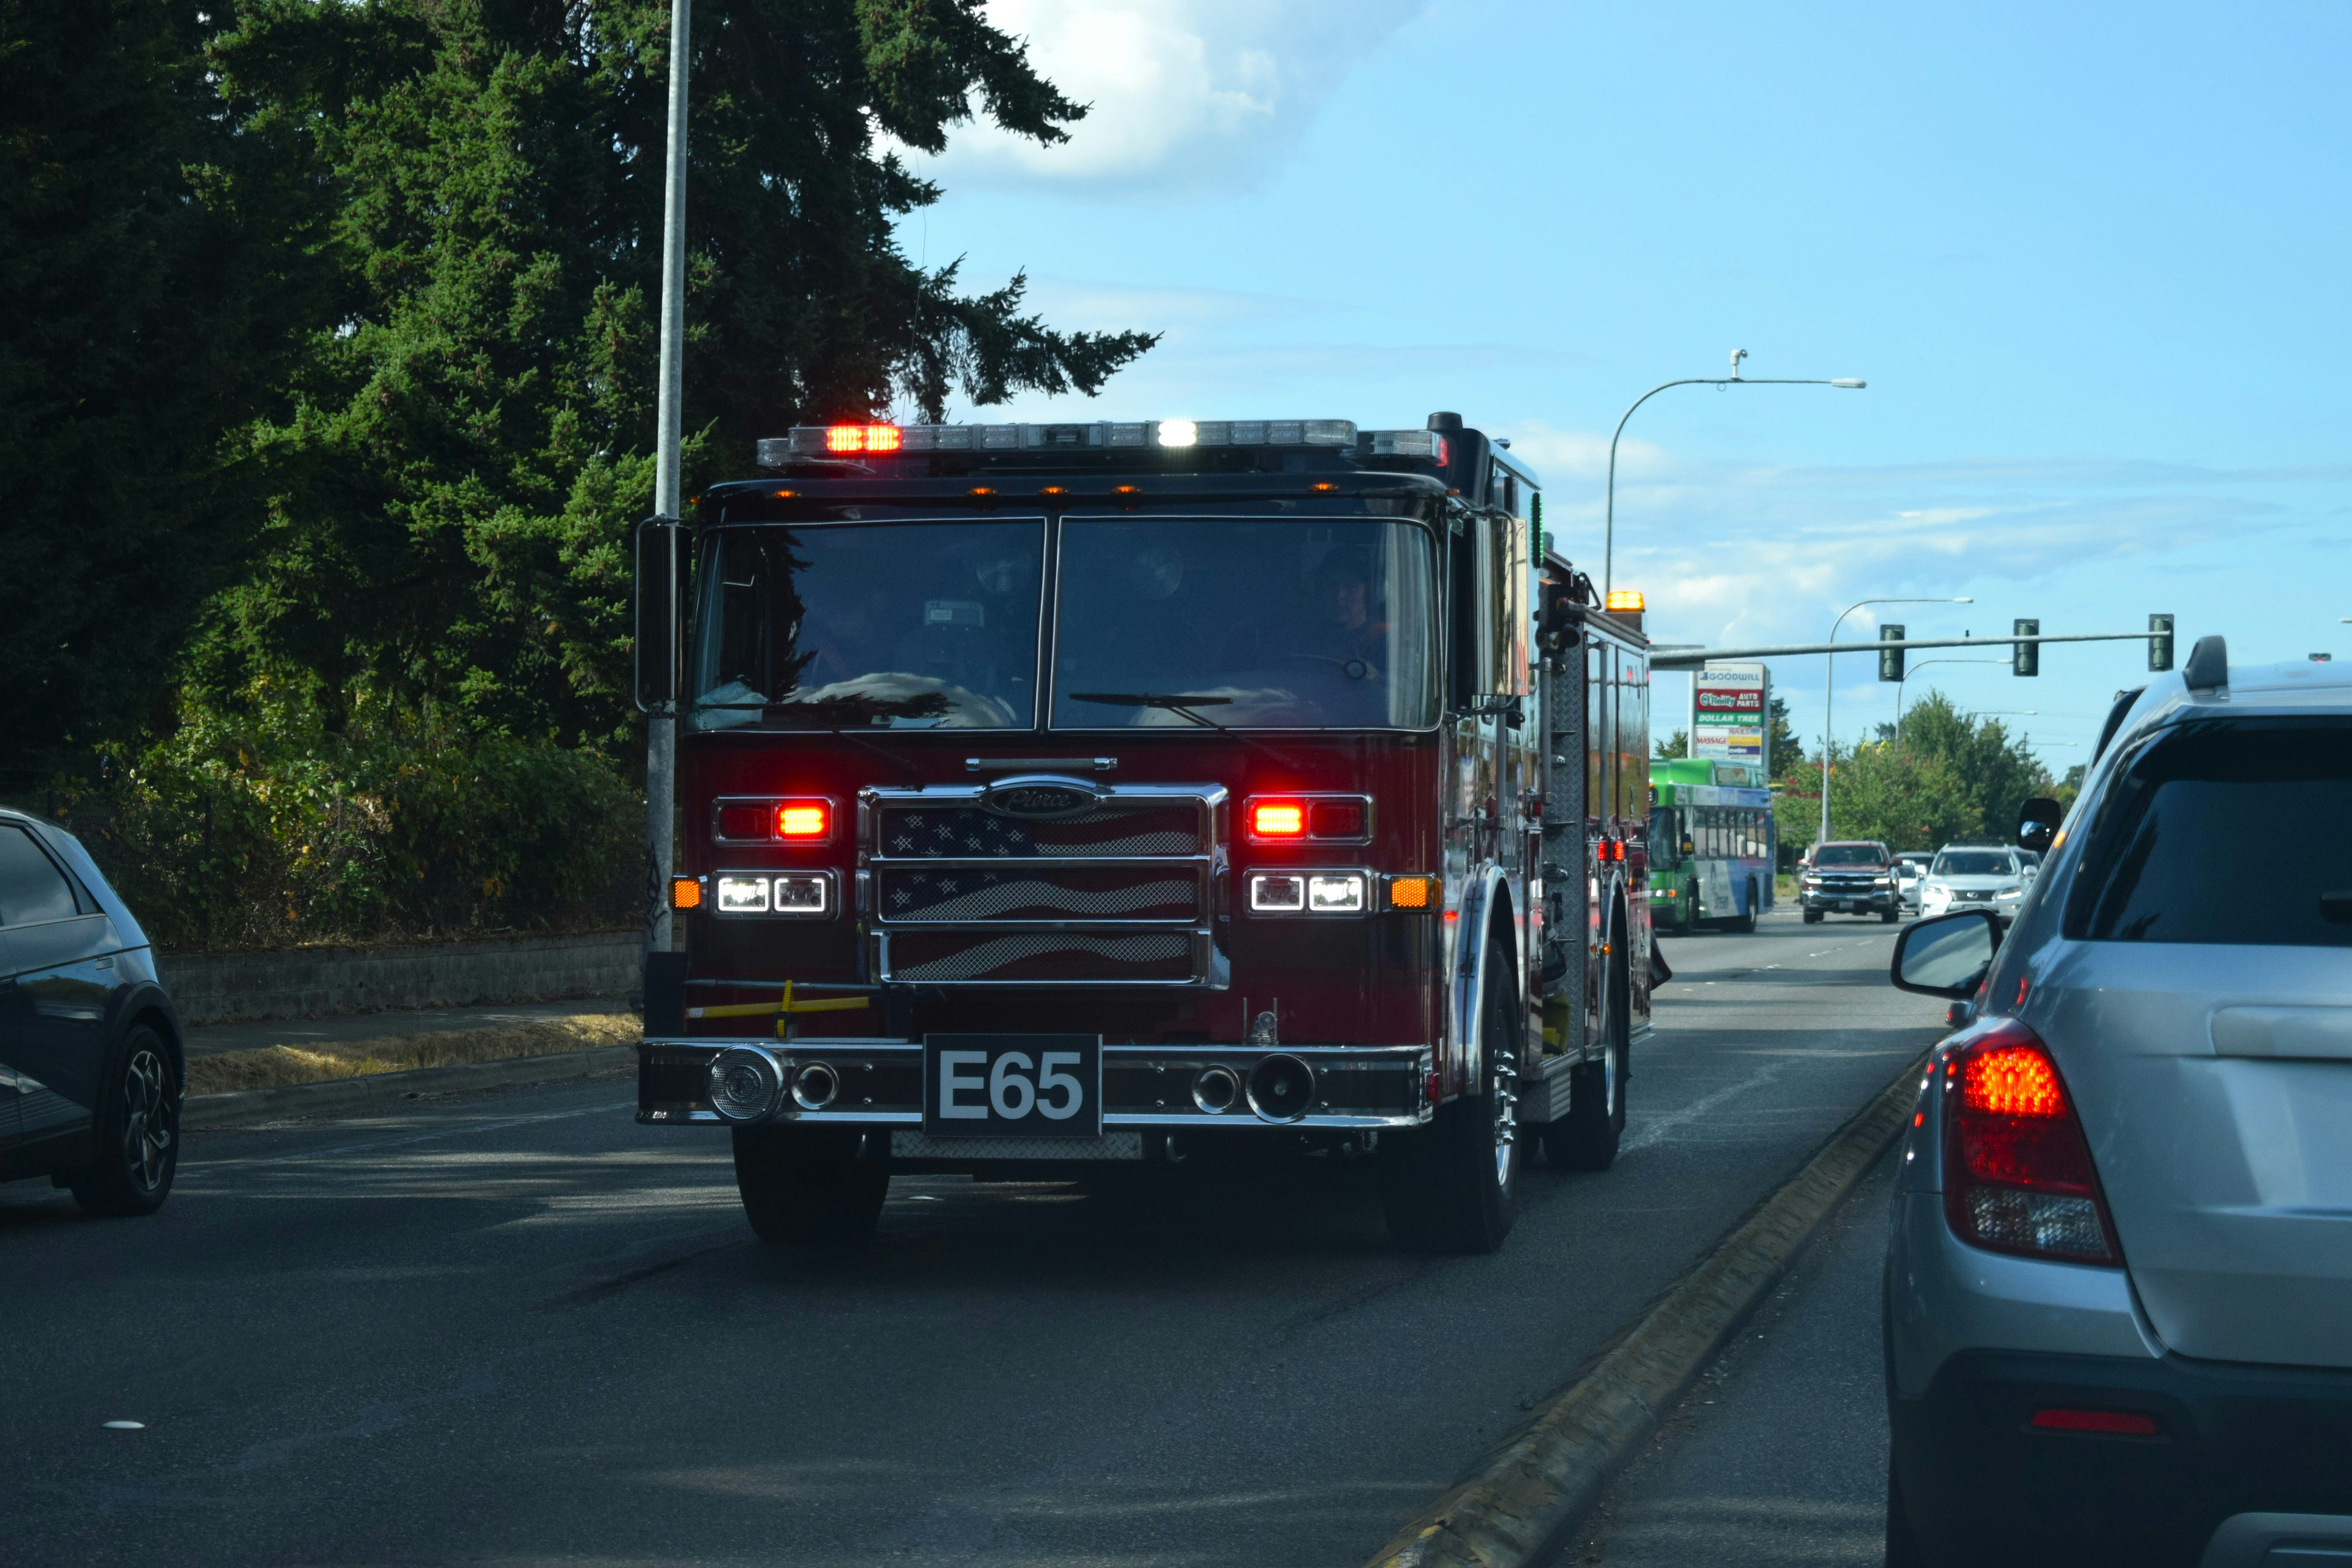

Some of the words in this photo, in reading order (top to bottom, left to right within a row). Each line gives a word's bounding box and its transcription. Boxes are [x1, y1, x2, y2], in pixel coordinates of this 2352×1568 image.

[1700, 693, 1736, 707] O'Reilly
[1004, 789, 1071, 811] Pierce
[939, 1051, 1083, 1120] E65
